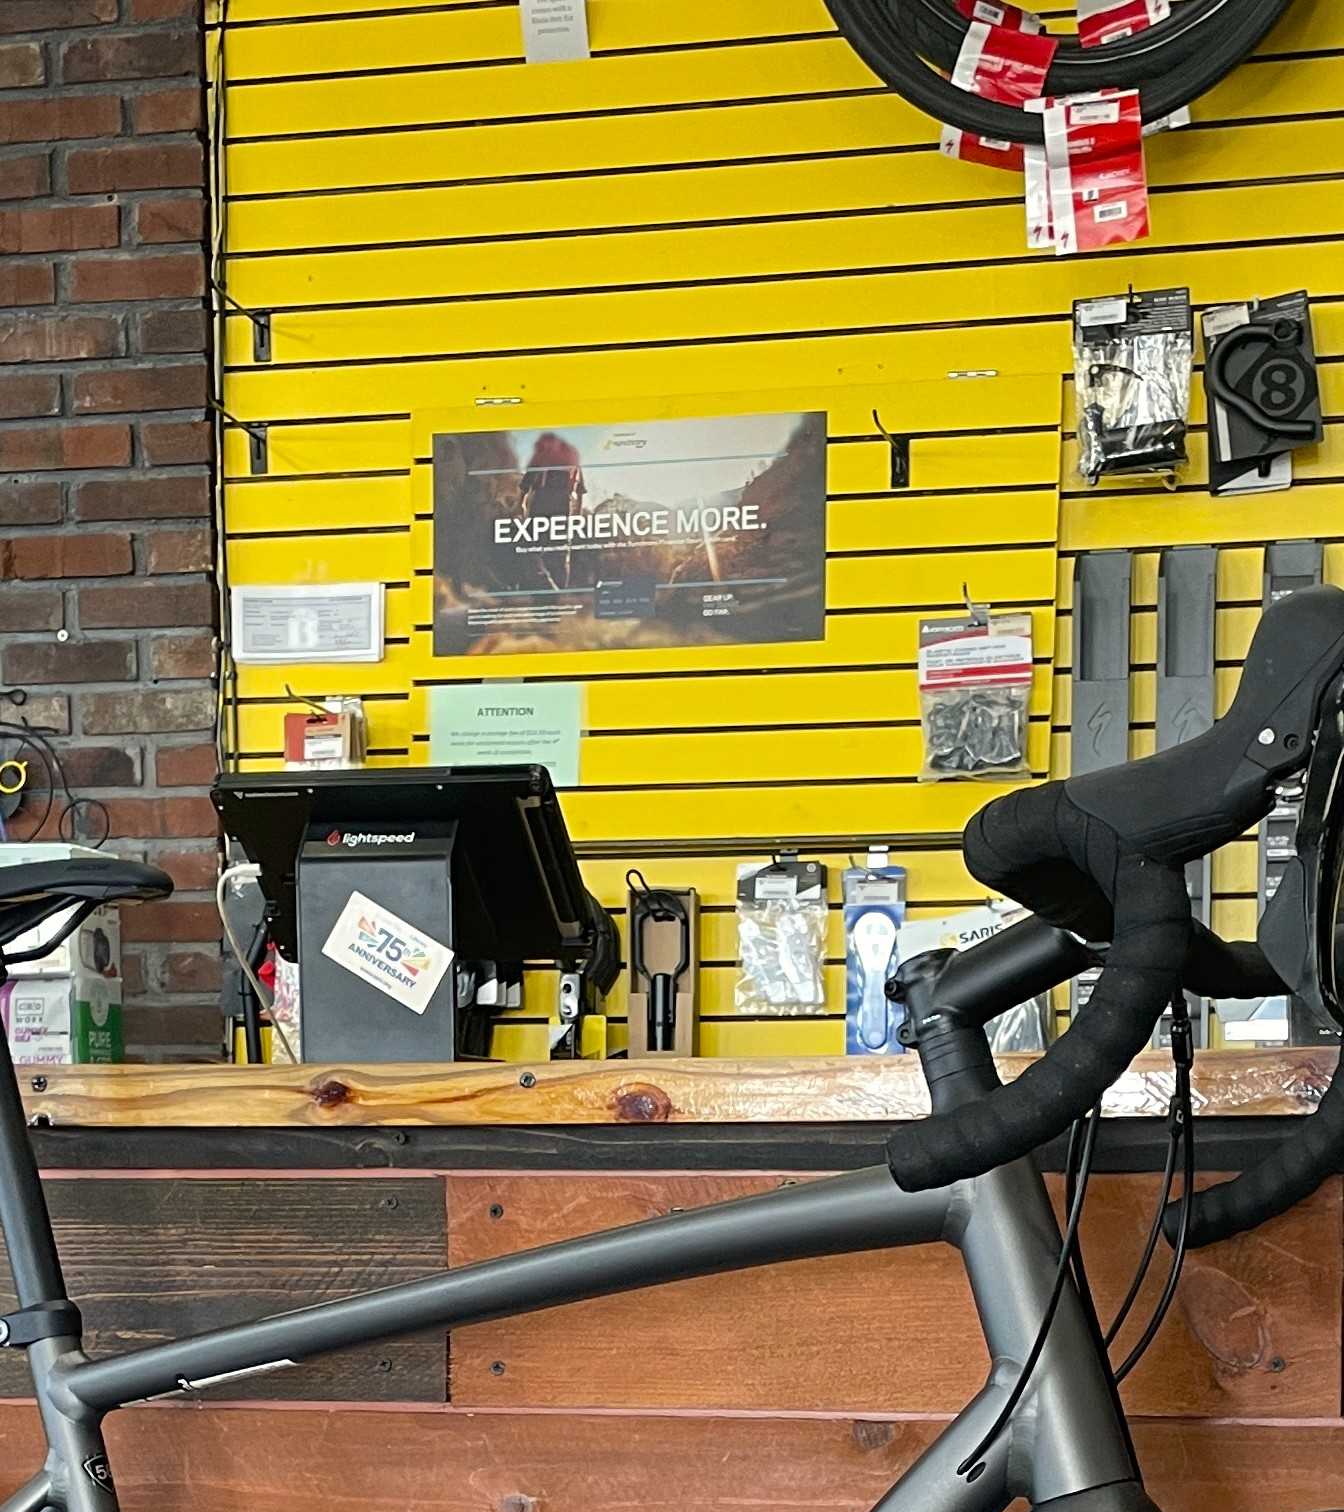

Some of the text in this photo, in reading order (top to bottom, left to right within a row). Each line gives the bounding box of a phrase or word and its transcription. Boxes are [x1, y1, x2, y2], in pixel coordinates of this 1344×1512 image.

[494, 505, 768, 544] EXPERIENCE MORE.
[477, 707, 534, 717] ATTENTION
[342, 832, 416, 847] lightspeed
[347, 942, 418, 989] ANNIVERSARY
